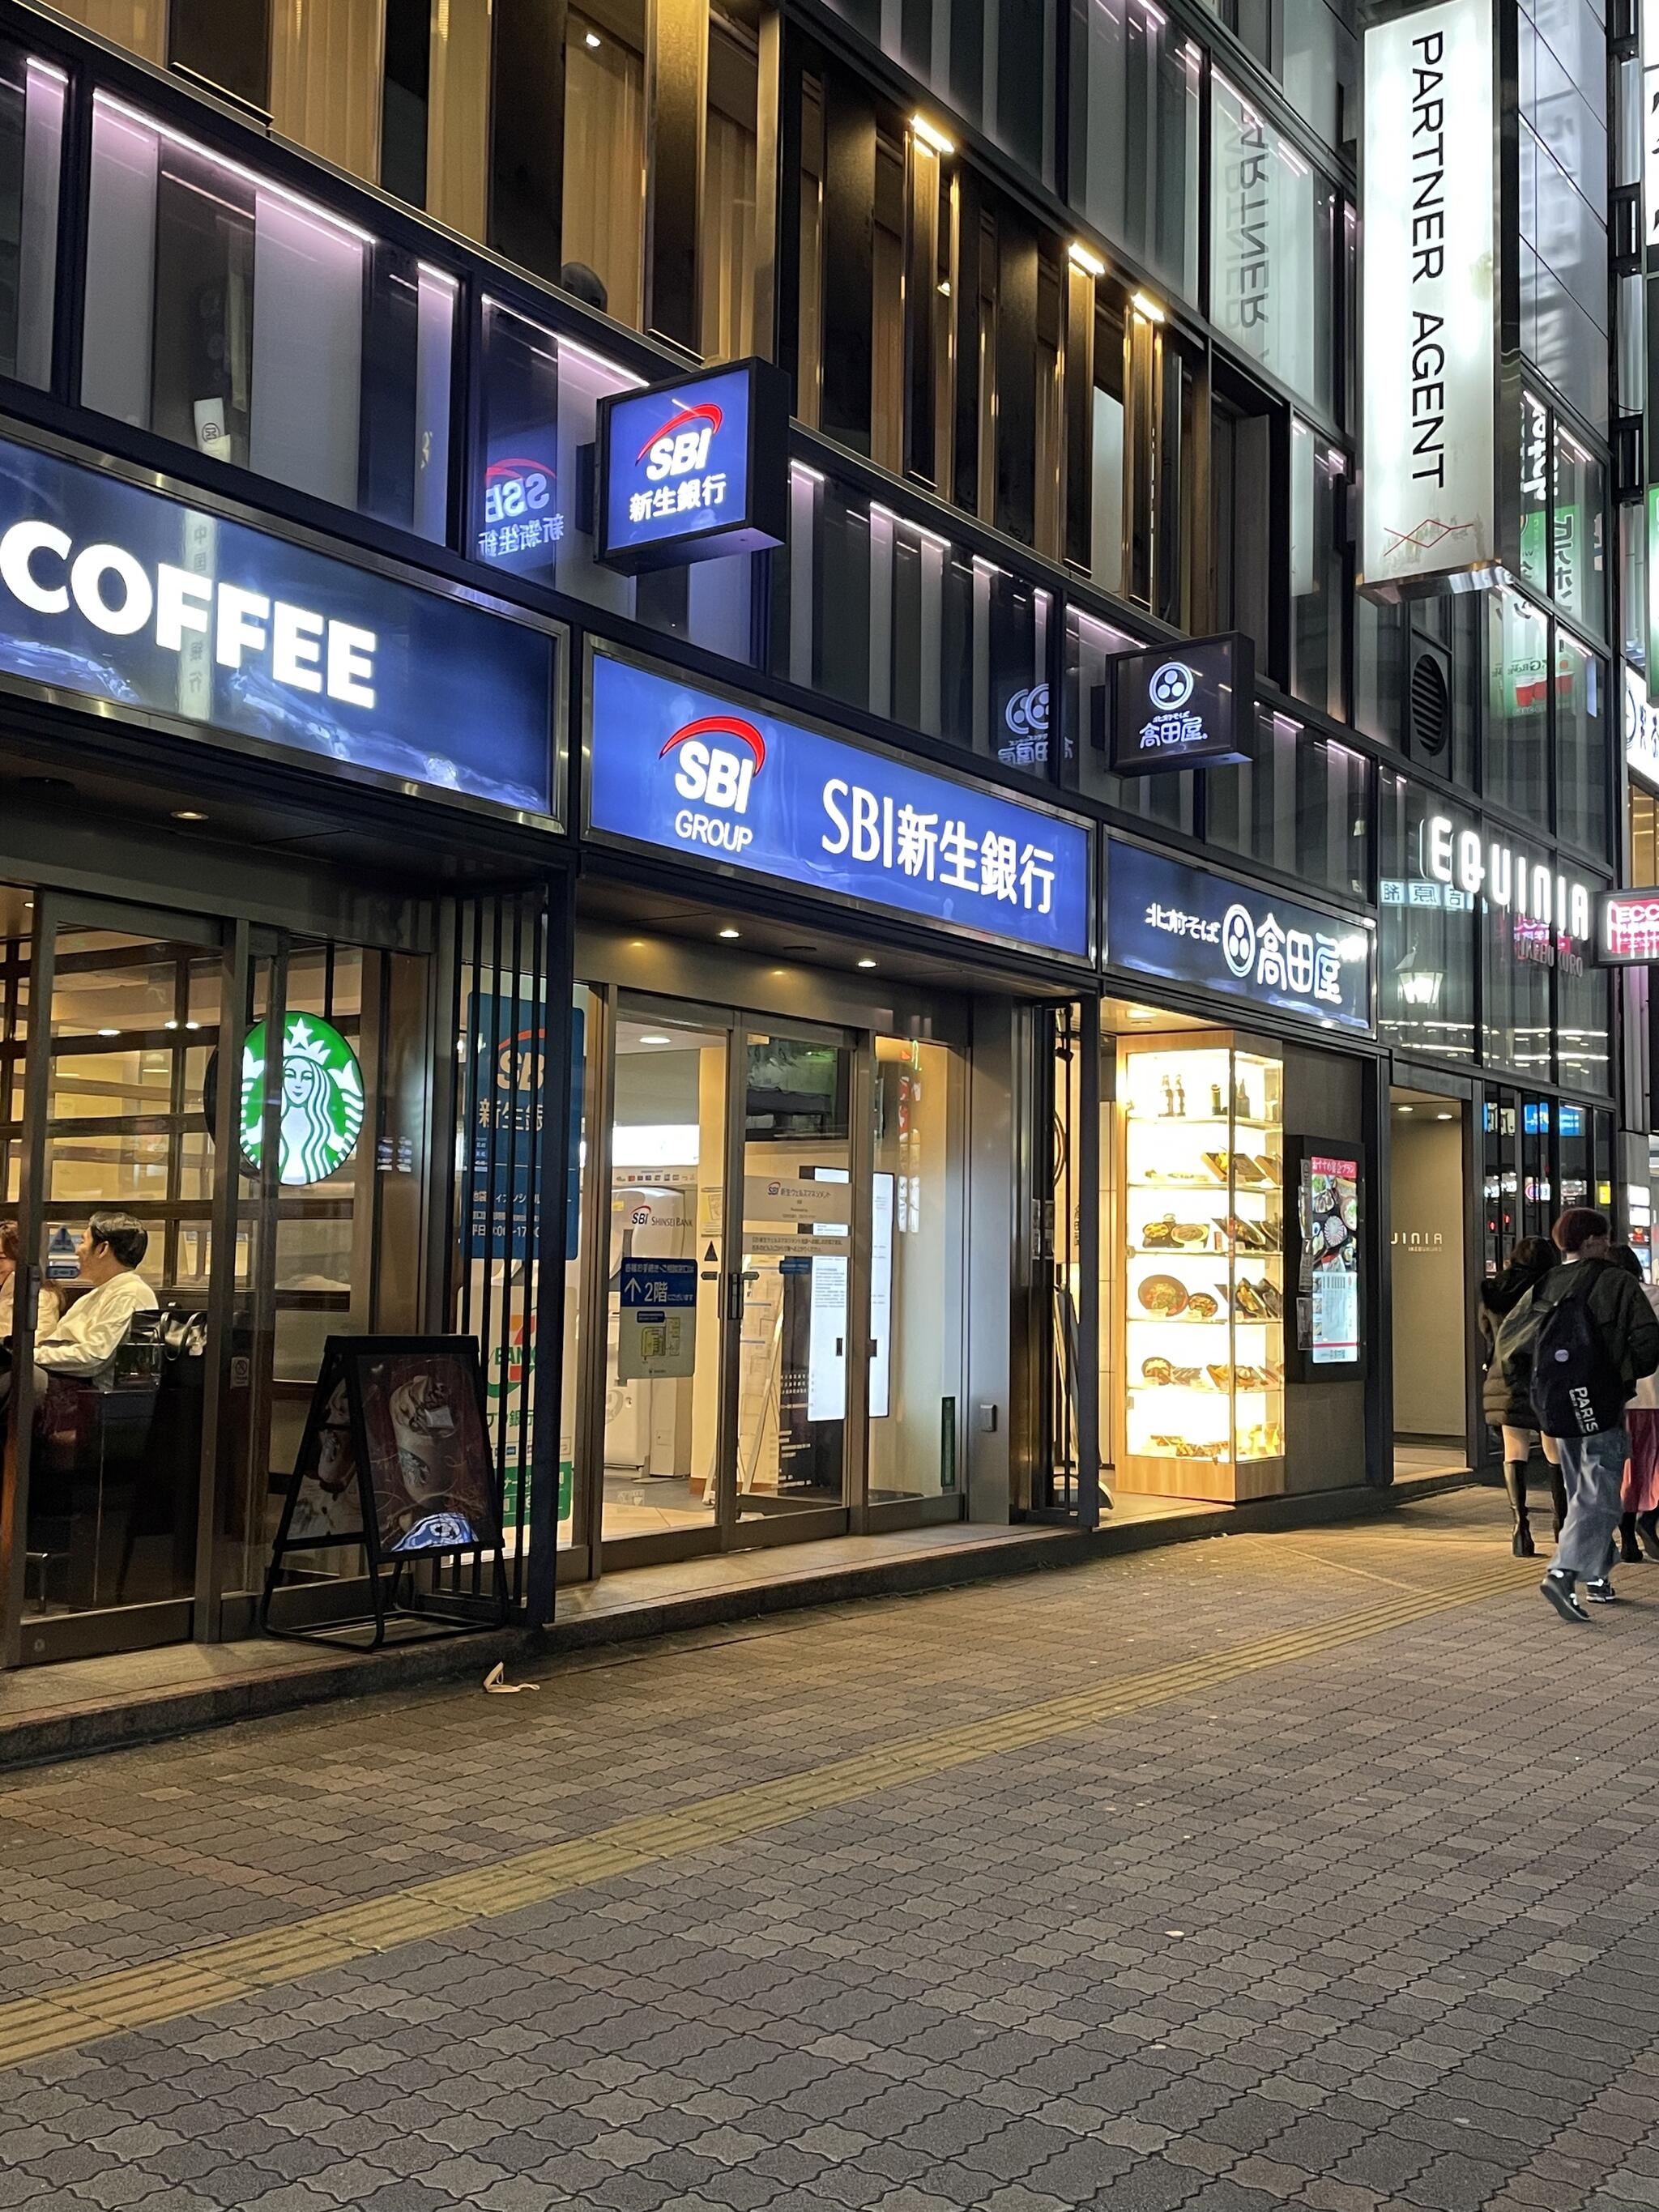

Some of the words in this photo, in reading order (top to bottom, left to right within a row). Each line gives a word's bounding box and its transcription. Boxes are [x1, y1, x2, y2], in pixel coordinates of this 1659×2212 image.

[1412, 31, 1444, 284] PARTNER
[1412, 310, 1444, 488] AGENT
[646, 428, 711, 480] SBI
[629, 473, 727, 522] 新生銀行
[0, 521, 376, 710] COFFEE
[1139, 716, 1202, 749] 高田屋
[675, 740, 753, 815] SBI
[675, 809, 753, 852] GROUP
[821, 778, 1055, 914] SBI新生銀行
[1145, 903, 1222, 944] 北前そば
[1256, 912, 1343, 1005] 高田屋
[632, 1213, 649, 1225] SBI
[1574, 1387, 1600, 1432] PARIS
